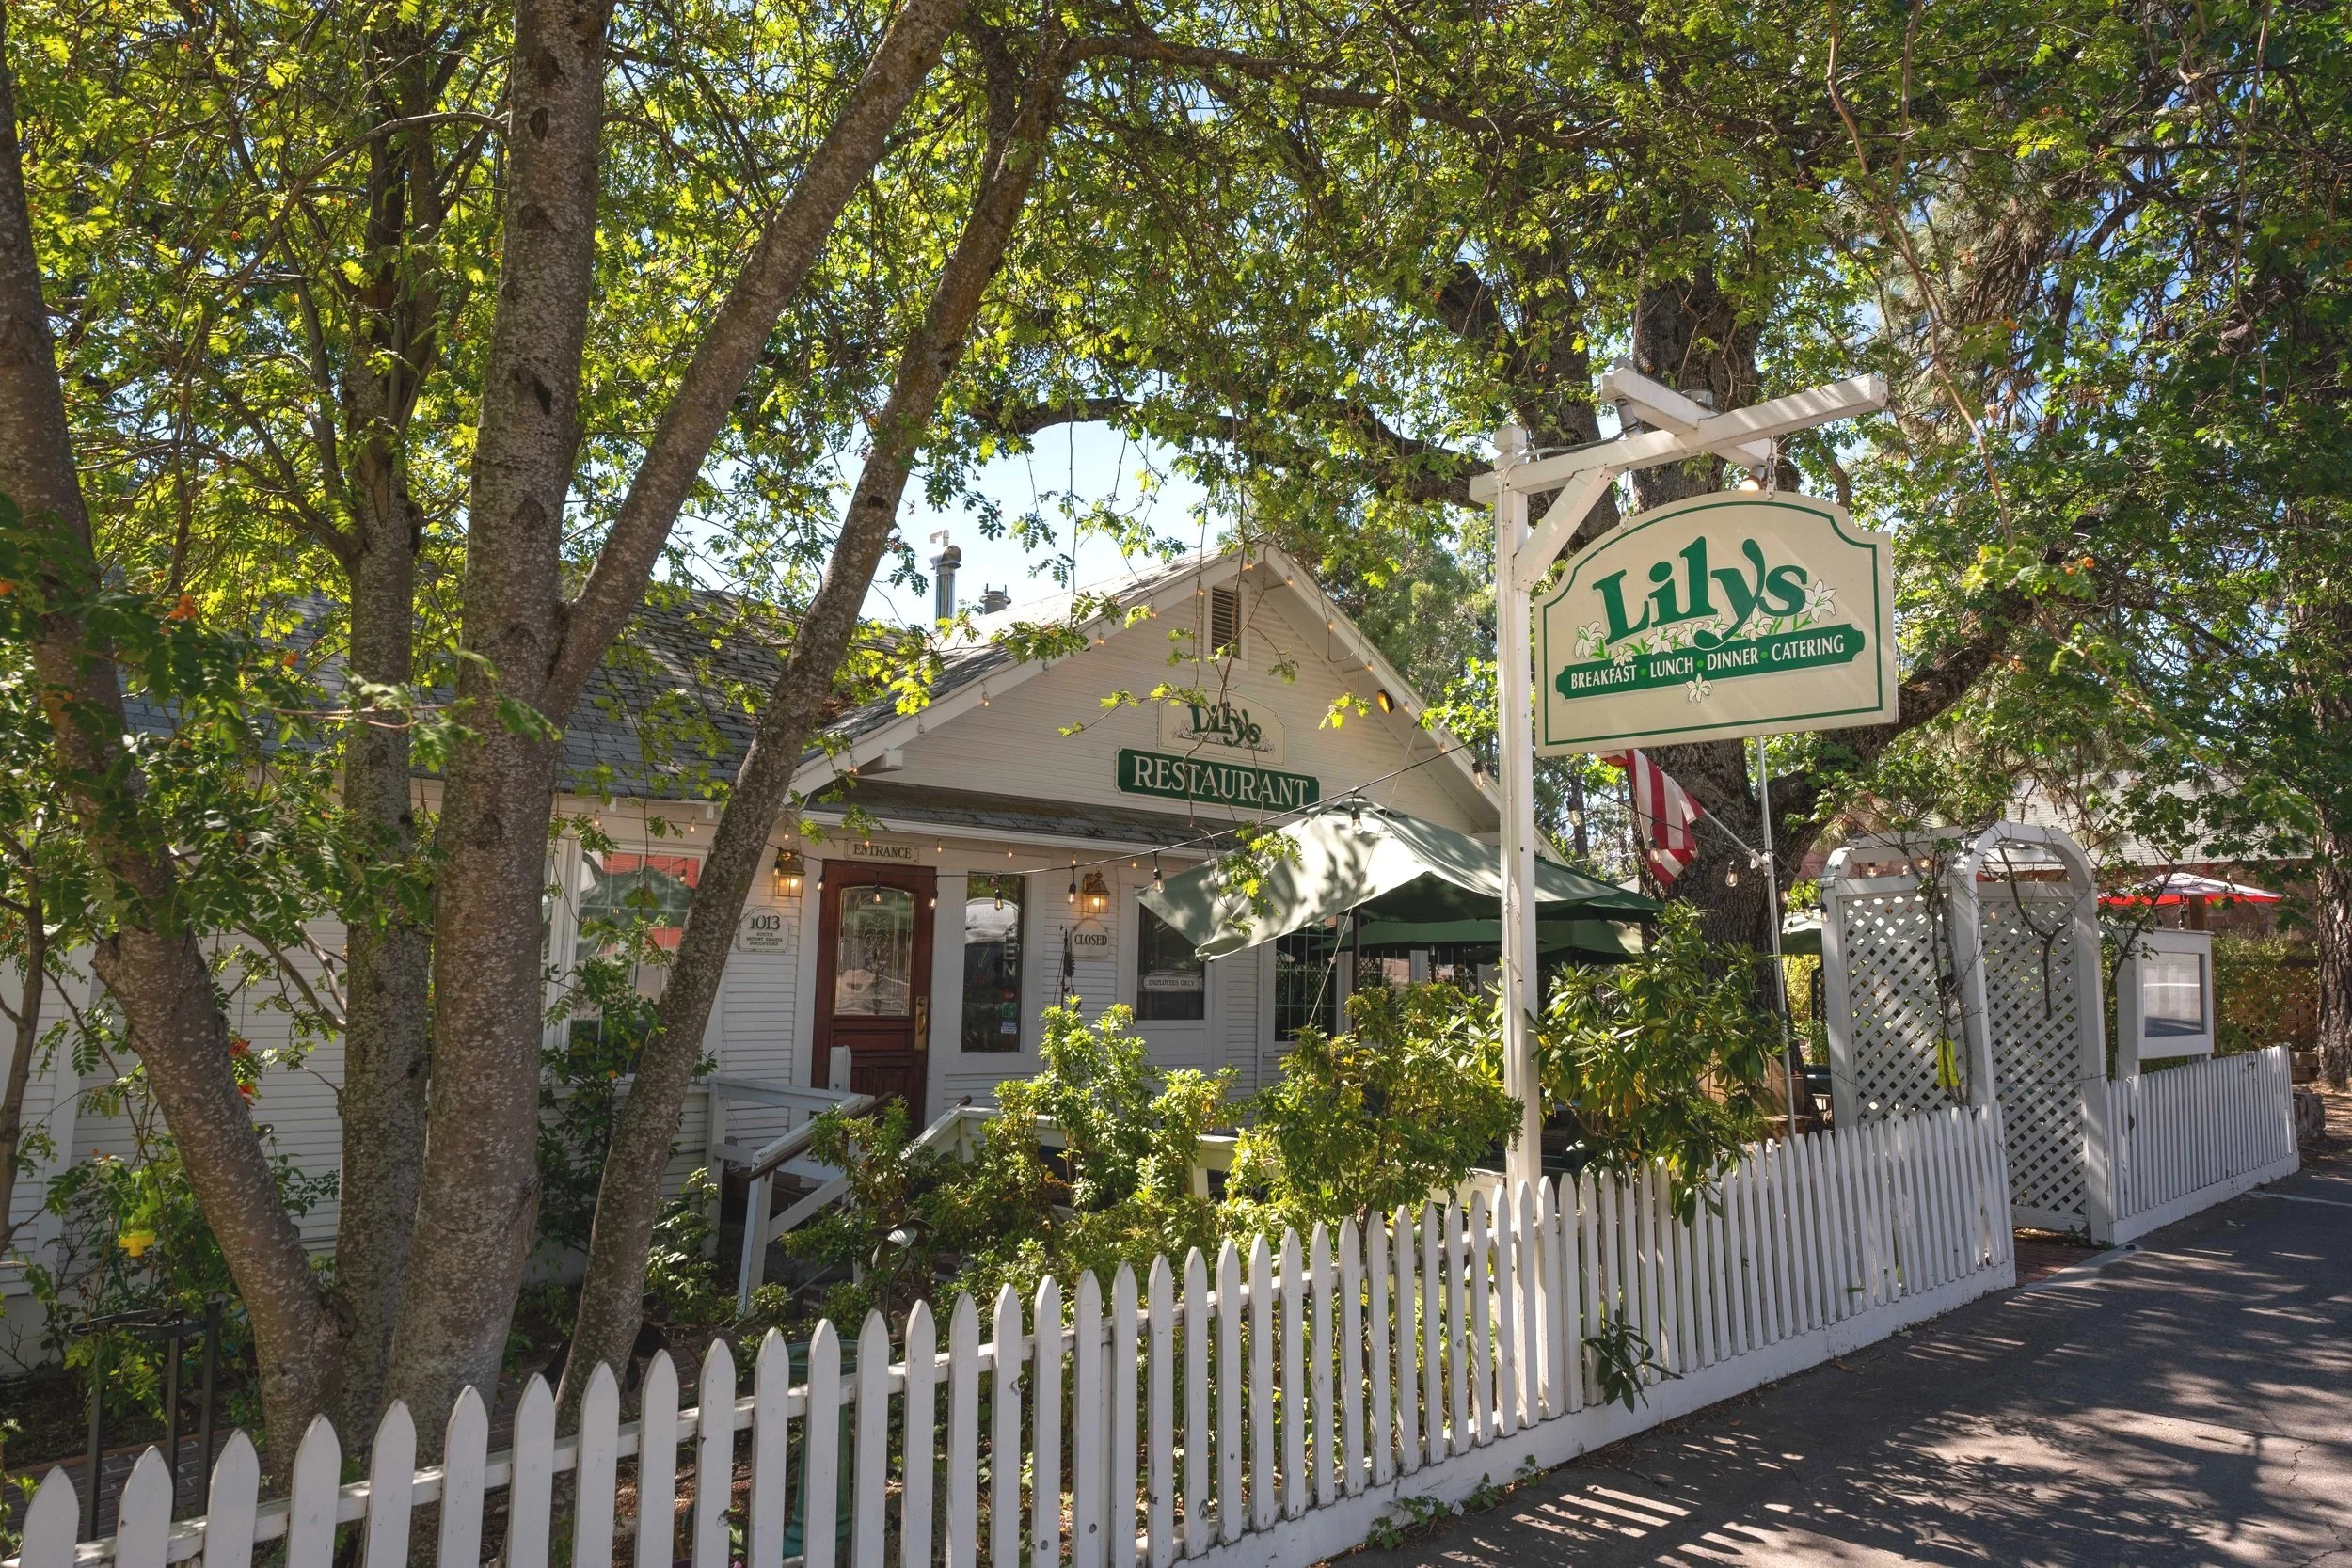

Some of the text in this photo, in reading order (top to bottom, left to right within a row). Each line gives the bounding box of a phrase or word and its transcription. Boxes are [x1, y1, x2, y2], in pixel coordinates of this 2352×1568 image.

[1570, 634, 1845, 689] BREAKFAST LUNCH DINNER CATERING
[1132, 755, 1309, 808] RESTAURANT
[852, 843, 912, 859] ENTRANCE
[750, 915, 781, 930] 1013
[1074, 934, 1108, 946] CLOSED
